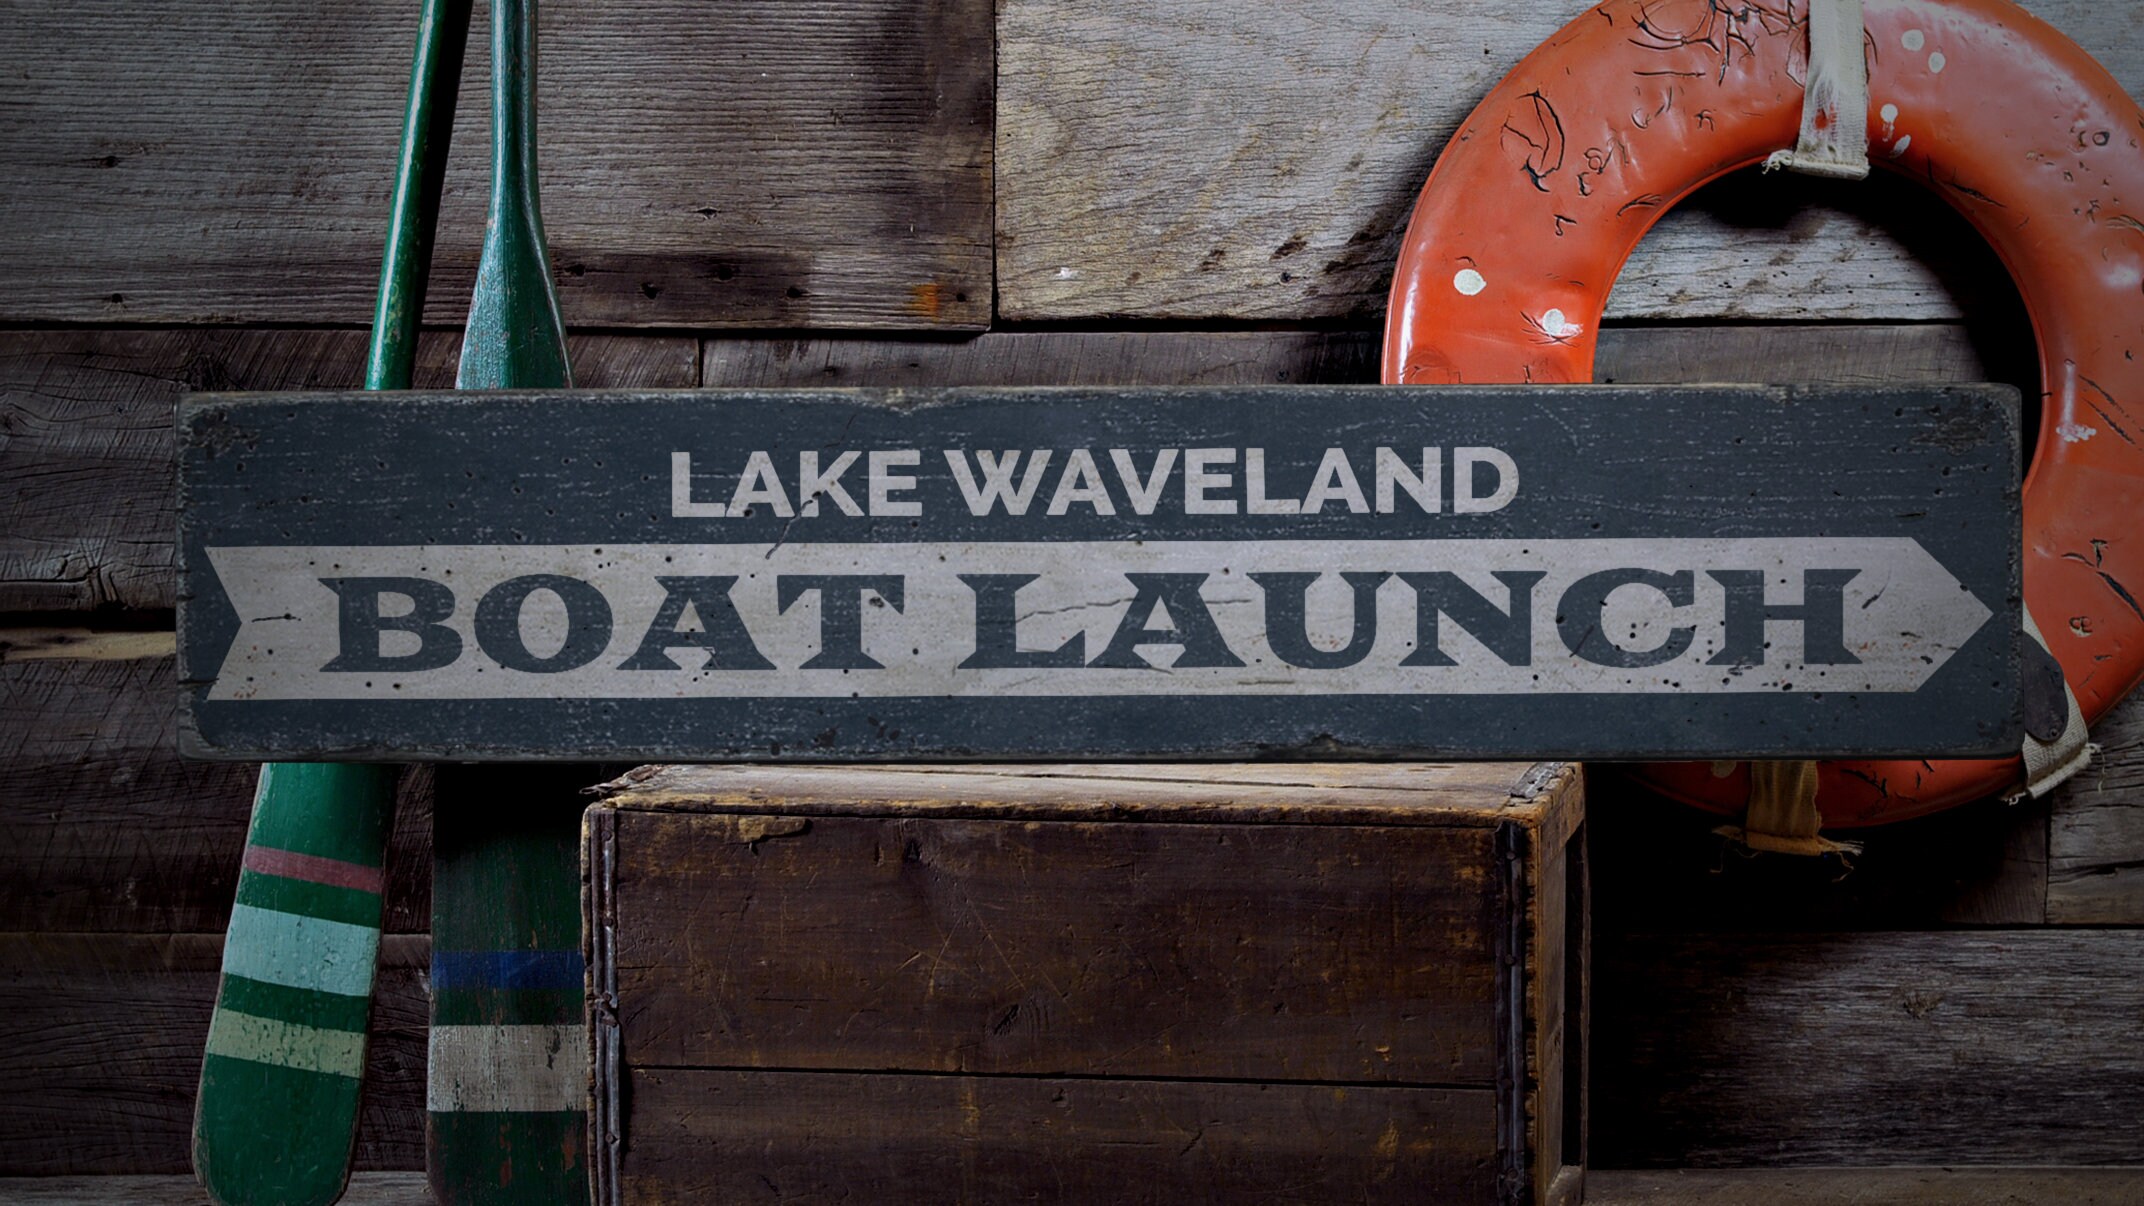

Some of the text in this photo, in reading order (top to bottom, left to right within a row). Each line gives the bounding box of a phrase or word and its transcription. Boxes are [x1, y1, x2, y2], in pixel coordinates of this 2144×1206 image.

[671, 446, 1520, 518] LAKE WAVELAND
[317, 567, 1863, 674] BOAT LAUNCH
